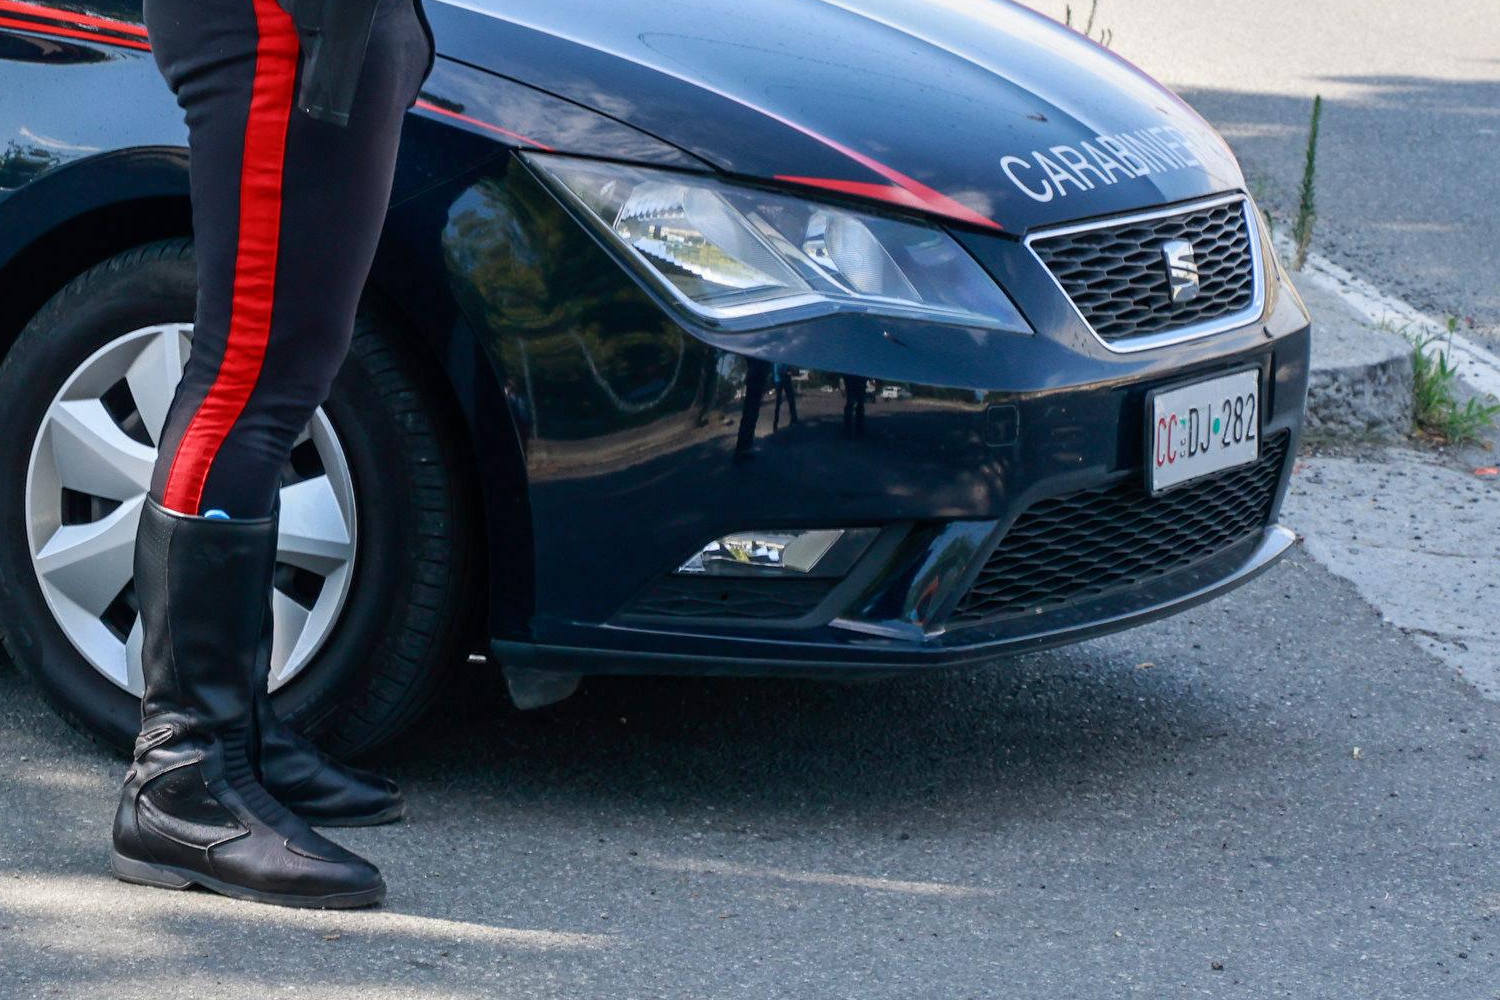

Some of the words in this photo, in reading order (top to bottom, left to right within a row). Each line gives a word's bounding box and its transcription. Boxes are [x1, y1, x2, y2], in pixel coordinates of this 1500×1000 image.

[999, 126, 1220, 203] CARABINIE
[1156, 413, 1178, 467] CC
[1221, 392, 1255, 446] 282
